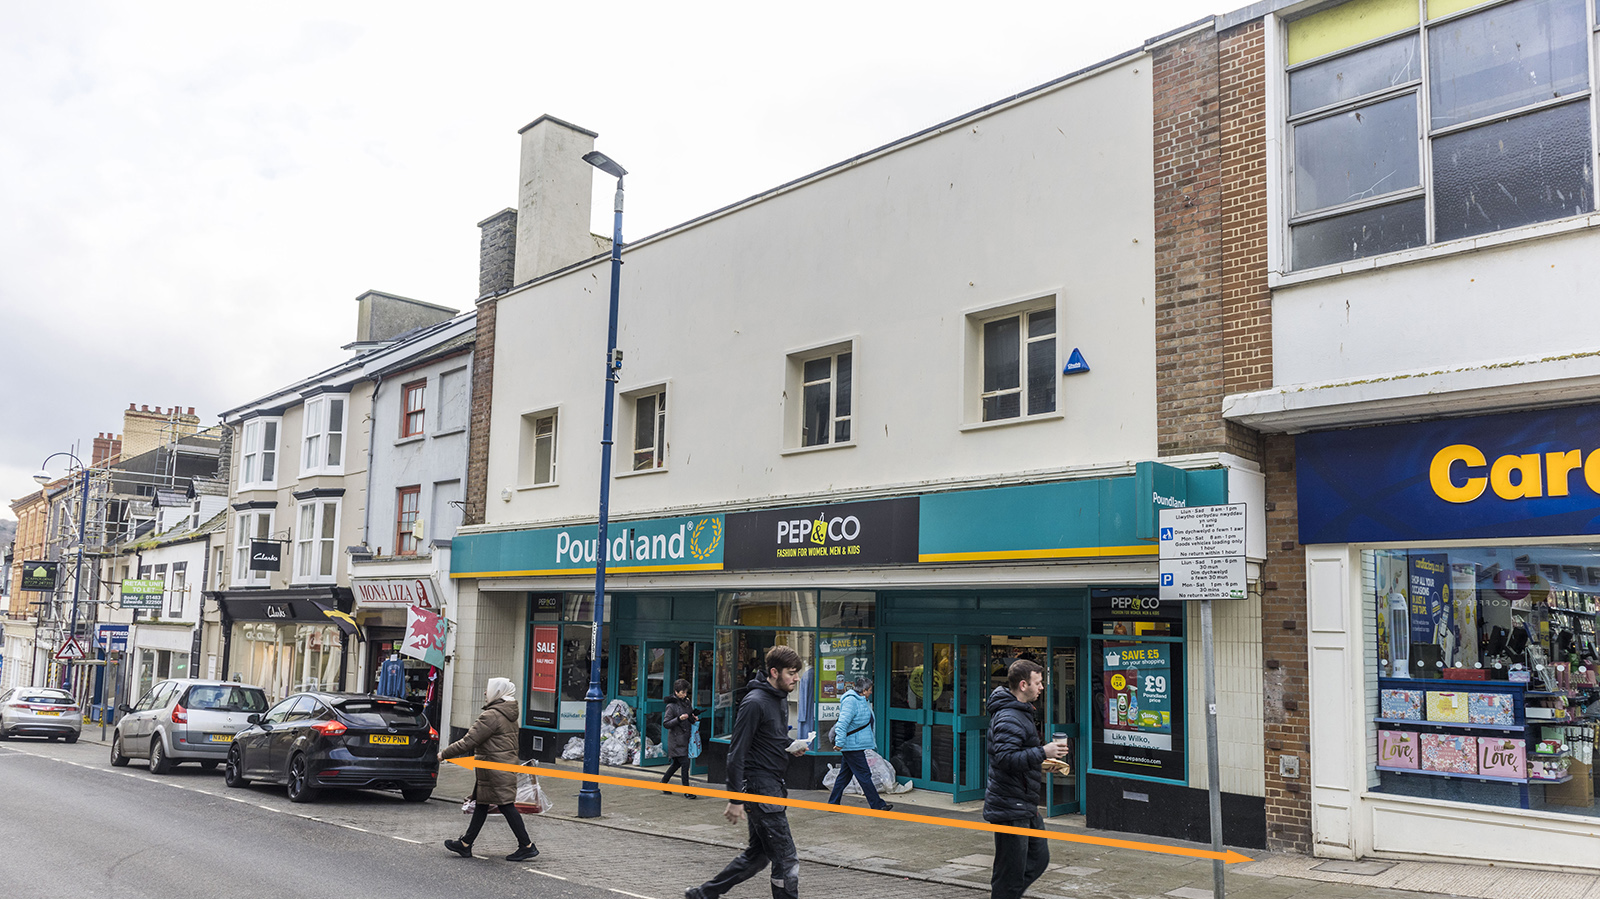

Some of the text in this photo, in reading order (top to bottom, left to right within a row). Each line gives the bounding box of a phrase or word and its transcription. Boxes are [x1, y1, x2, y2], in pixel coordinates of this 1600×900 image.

[1152, 492, 1186, 508] Poundland
[556, 524, 686, 563] Poudland
[253, 552, 278, 562] Clarks
[776, 545, 861, 558] FASHION FOR WOMEN, MEN & KIDS
[1164, 574, 1172, 585] P
[1426, 578, 1435, 587] YOUR
[359, 584, 414, 601] MONA LIZA
[1412, 585, 1429, 596] OCCASIONS
[267, 606, 286, 618] Clarks
[537, 642, 555, 653] SALE
[832, 639, 851, 648] SAVE
[1122, 649, 1159, 660] SAVE £5
[852, 657, 868, 670] £7
[1144, 675, 1166, 693] £9
[1112, 733, 1150, 744] Like Wilko,
[1382, 739, 1413, 760] Love
[1484, 746, 1517, 769] Love
